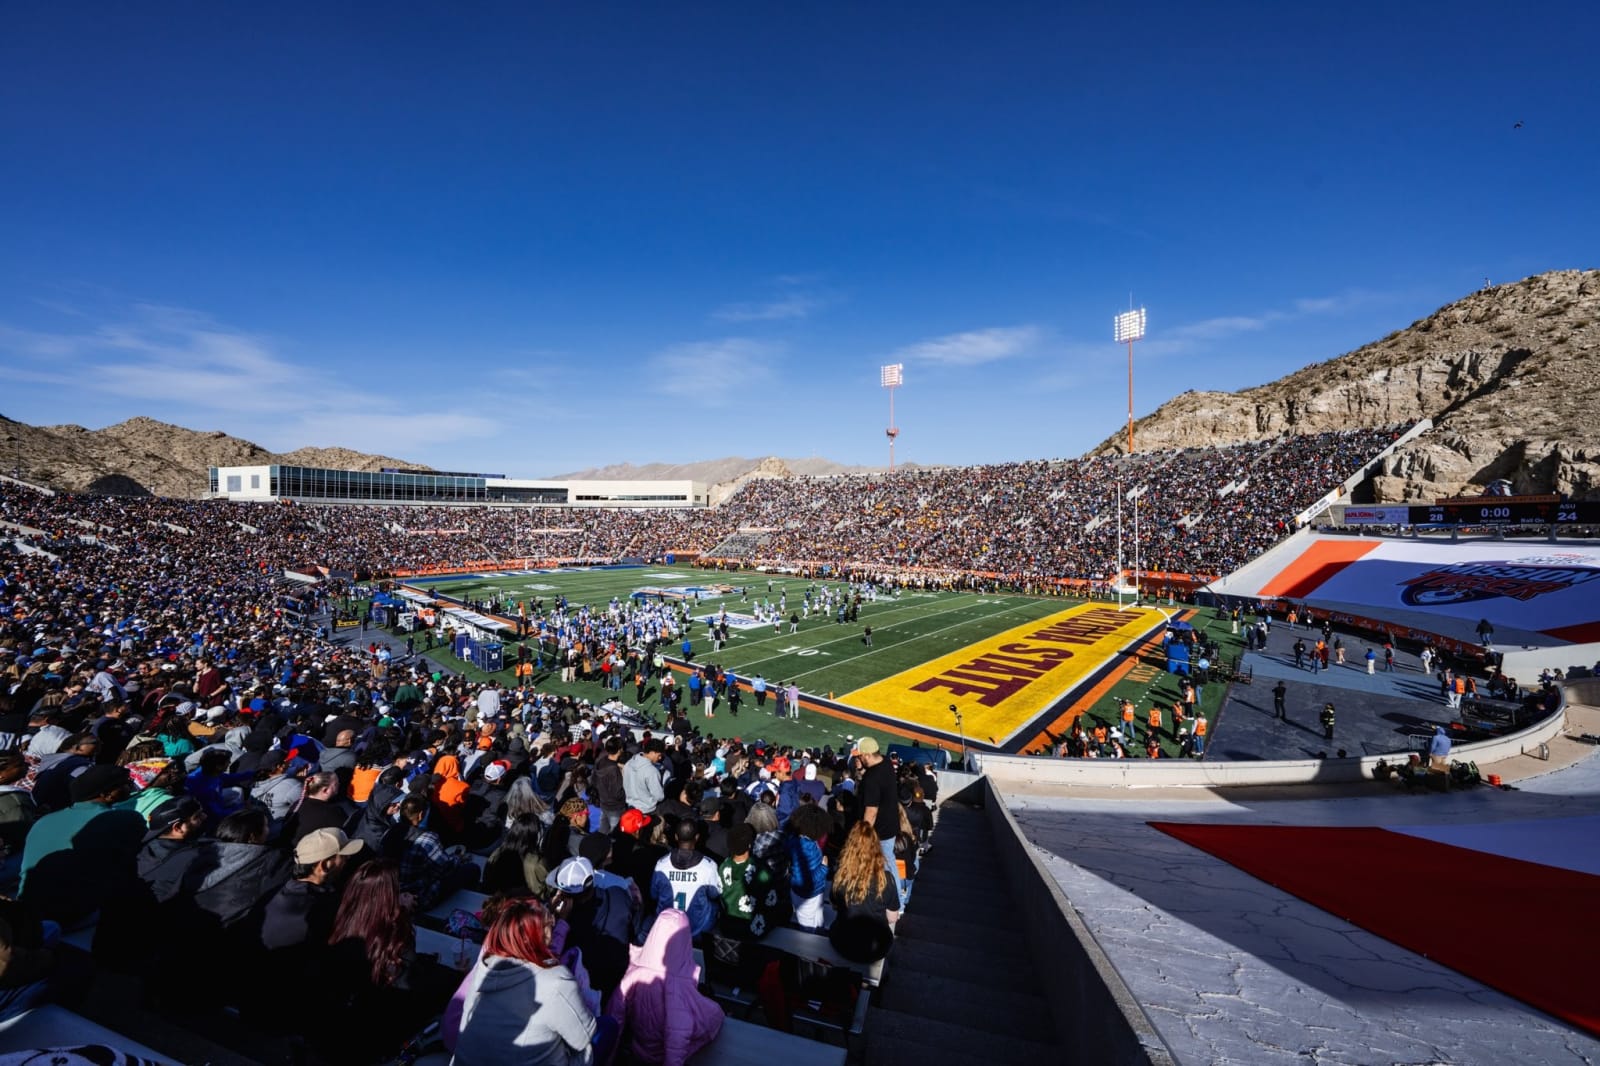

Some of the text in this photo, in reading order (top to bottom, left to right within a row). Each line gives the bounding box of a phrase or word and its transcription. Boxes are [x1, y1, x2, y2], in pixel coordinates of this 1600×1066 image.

[1429, 513, 1444, 522] 28
[1480, 507, 1510, 517] 0:00
[1557, 511, 1578, 521] 24
[1421, 564, 1600, 584] MISSION
[1024, 607, 1146, 645] ARIZONA
[909, 642, 1075, 708] STATE
[669, 871, 697, 882] HURTS
[675, 892, 687, 911] 1
